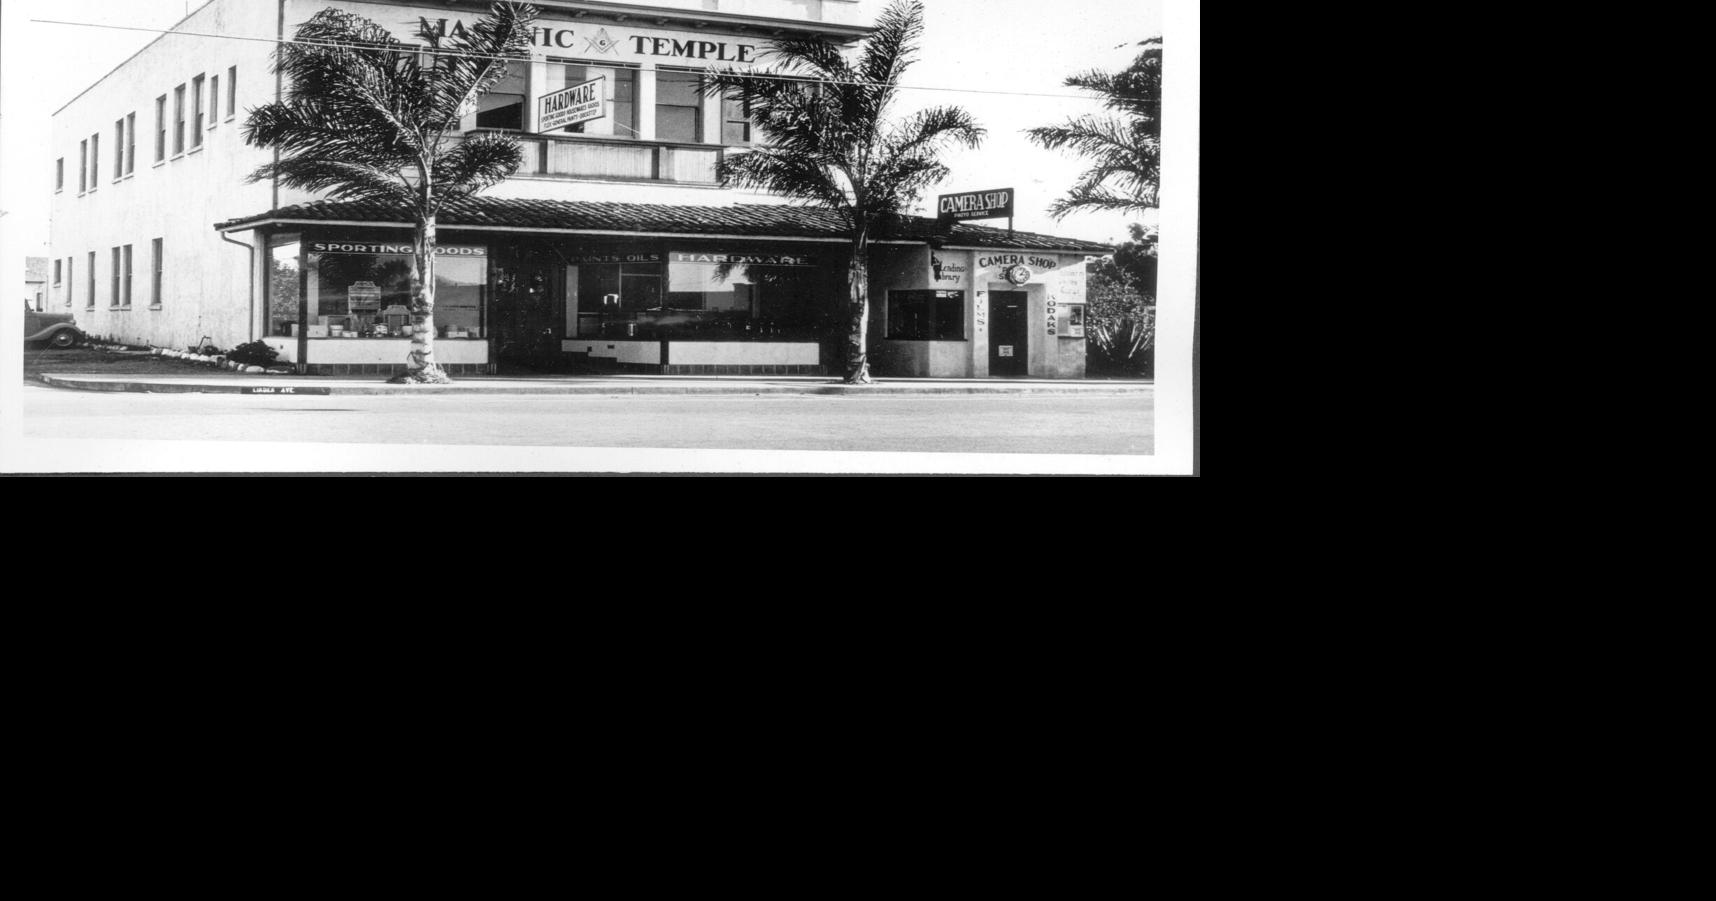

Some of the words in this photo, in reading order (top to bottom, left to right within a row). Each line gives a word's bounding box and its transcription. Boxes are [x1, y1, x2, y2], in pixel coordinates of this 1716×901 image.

[418, 16, 575, 48] MANIC
[629, 35, 756, 64] TEMPLE
[545, 83, 596, 114] HARDWARE
[940, 193, 984, 213] CAMERA
[985, 191, 1009, 209] SHOP
[314, 243, 413, 254] SPORTING
[434, 247, 485, 256] OODS
[626, 254, 660, 262] OILS
[677, 254, 809, 265] HARDWARE
[979, 254, 1025, 268] CAMERA
[1029, 255, 1057, 270] SHOP
